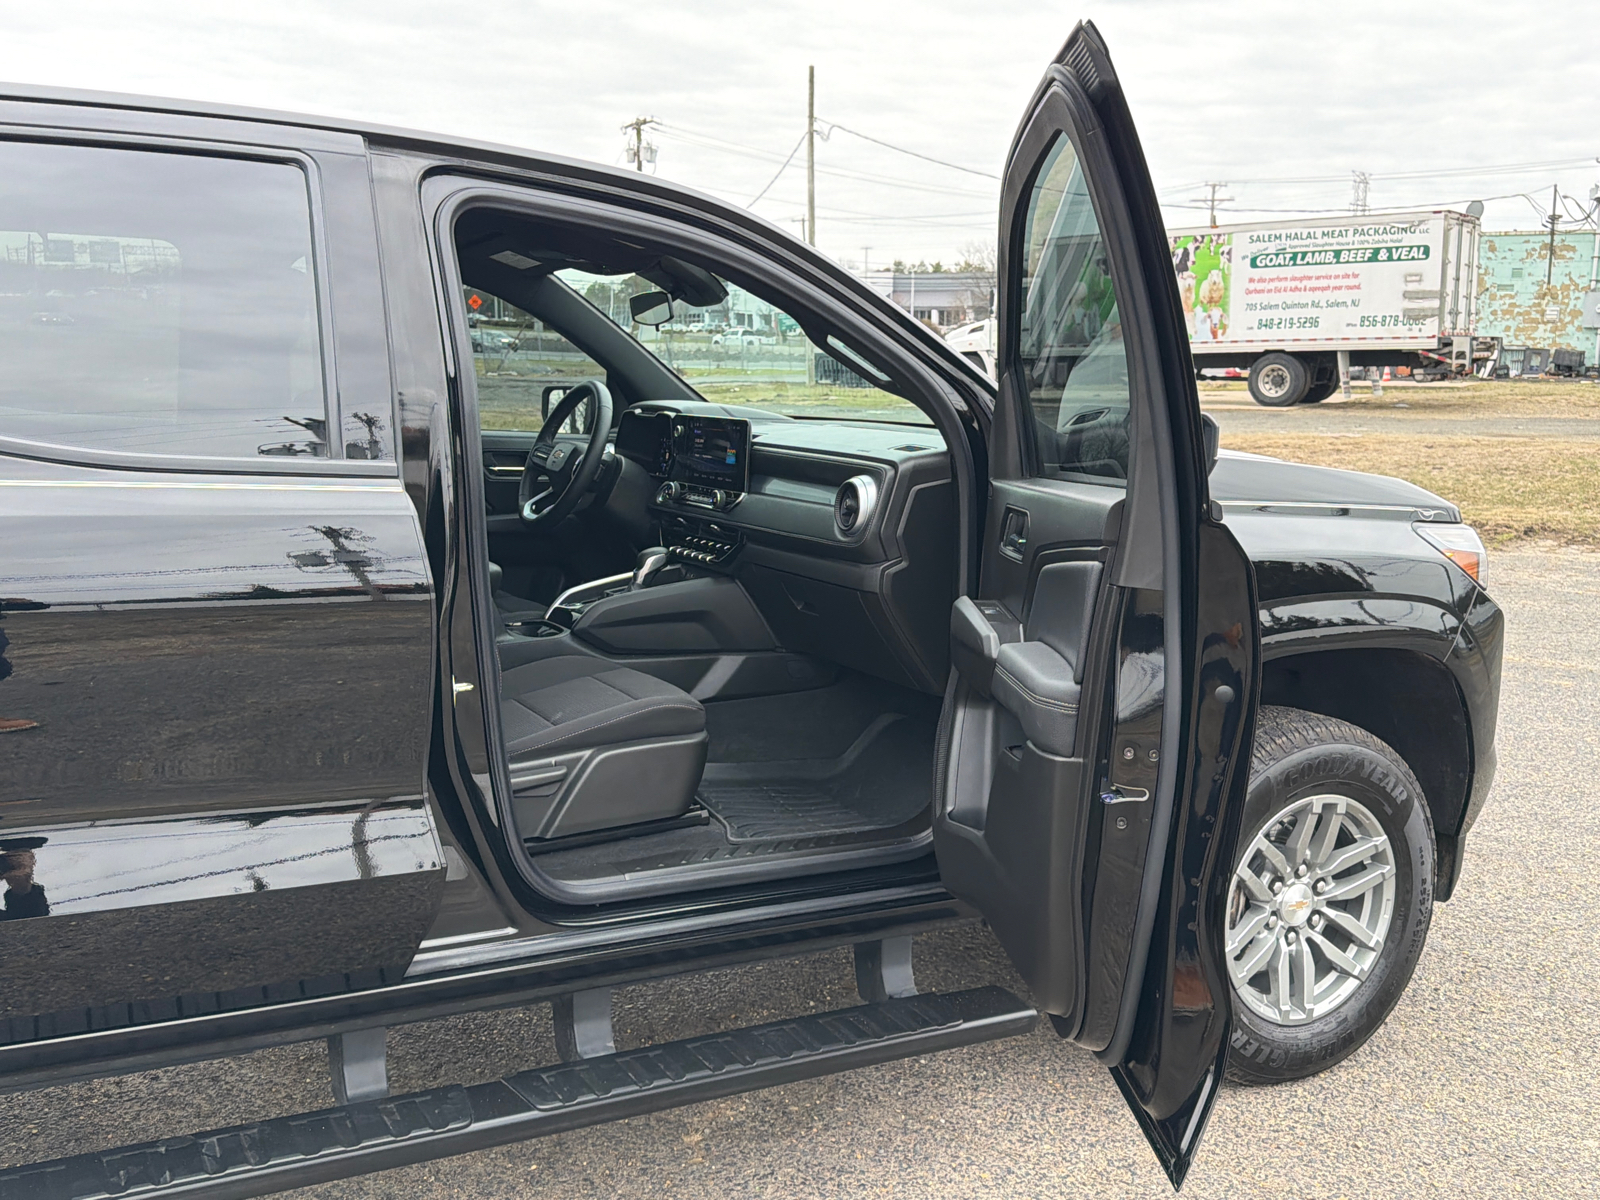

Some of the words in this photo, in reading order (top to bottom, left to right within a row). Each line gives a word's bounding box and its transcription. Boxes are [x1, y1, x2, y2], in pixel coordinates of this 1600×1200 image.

[1248, 233, 1282, 244] SALEM
[1285, 230, 1318, 242] HALAL
[1321, 228, 1350, 239] MEAT
[1352, 225, 1417, 237] PACKAGING
[1255, 252, 1295, 267] GOAT,
[1296, 250, 1337, 264] LAMB,
[1339, 248, 1374, 263] BEEF
[1377, 248, 1389, 261] &
[1391, 246, 1427, 260] VEAL
[1267, 274, 1289, 285] perform
[1289, 273, 1313, 284] slaughter
[1314, 273, 1332, 281] service
[1245, 302, 1258, 312] 705
[1259, 301, 1280, 311] Salem
[1281, 300, 1309, 311] Quinton
[1325, 299, 1349, 309] Salem,
[1350, 298, 1361, 307] NJ
[1257, 315, 1320, 330] 848-219-5296
